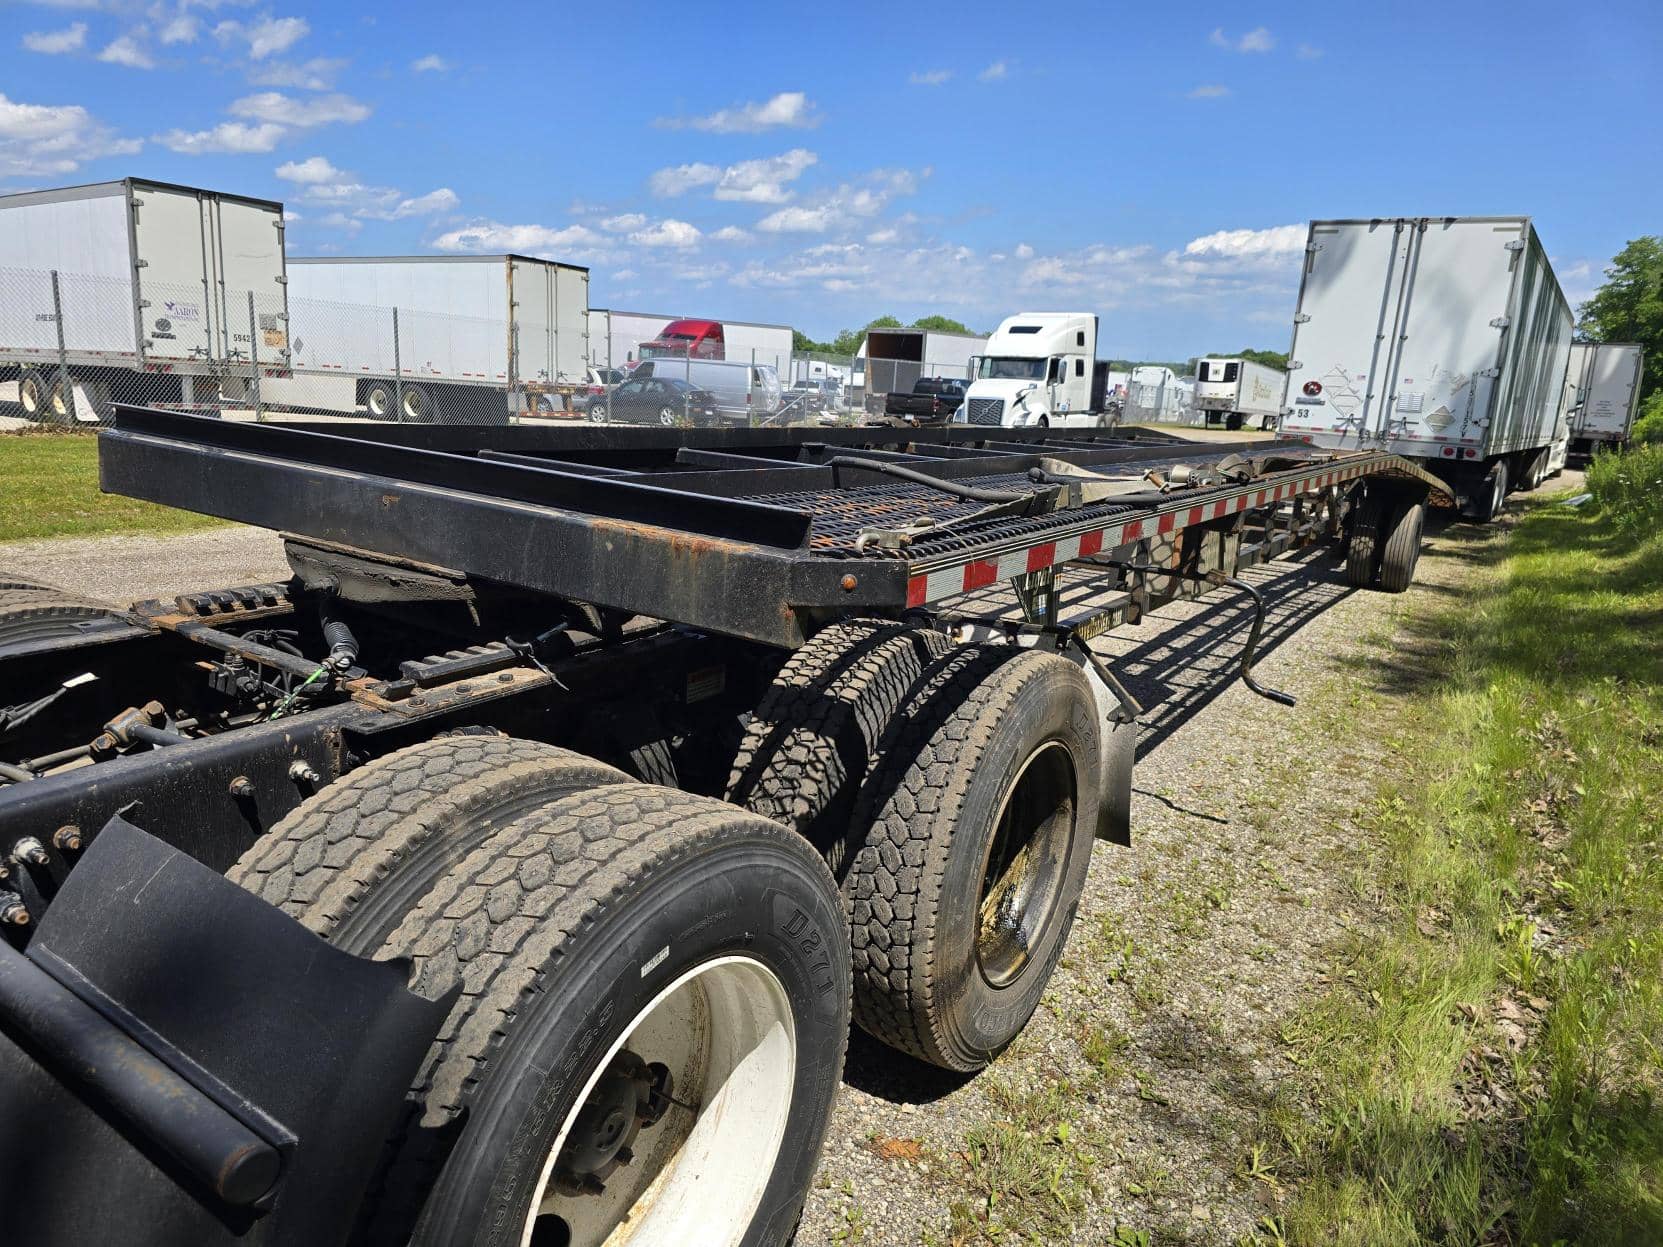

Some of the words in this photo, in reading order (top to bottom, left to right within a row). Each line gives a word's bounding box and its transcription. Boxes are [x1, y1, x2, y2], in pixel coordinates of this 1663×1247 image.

[174, 306, 199, 316] AARON
[1297, 408, 1310, 418] 53
[781, 908, 835, 996] D271
